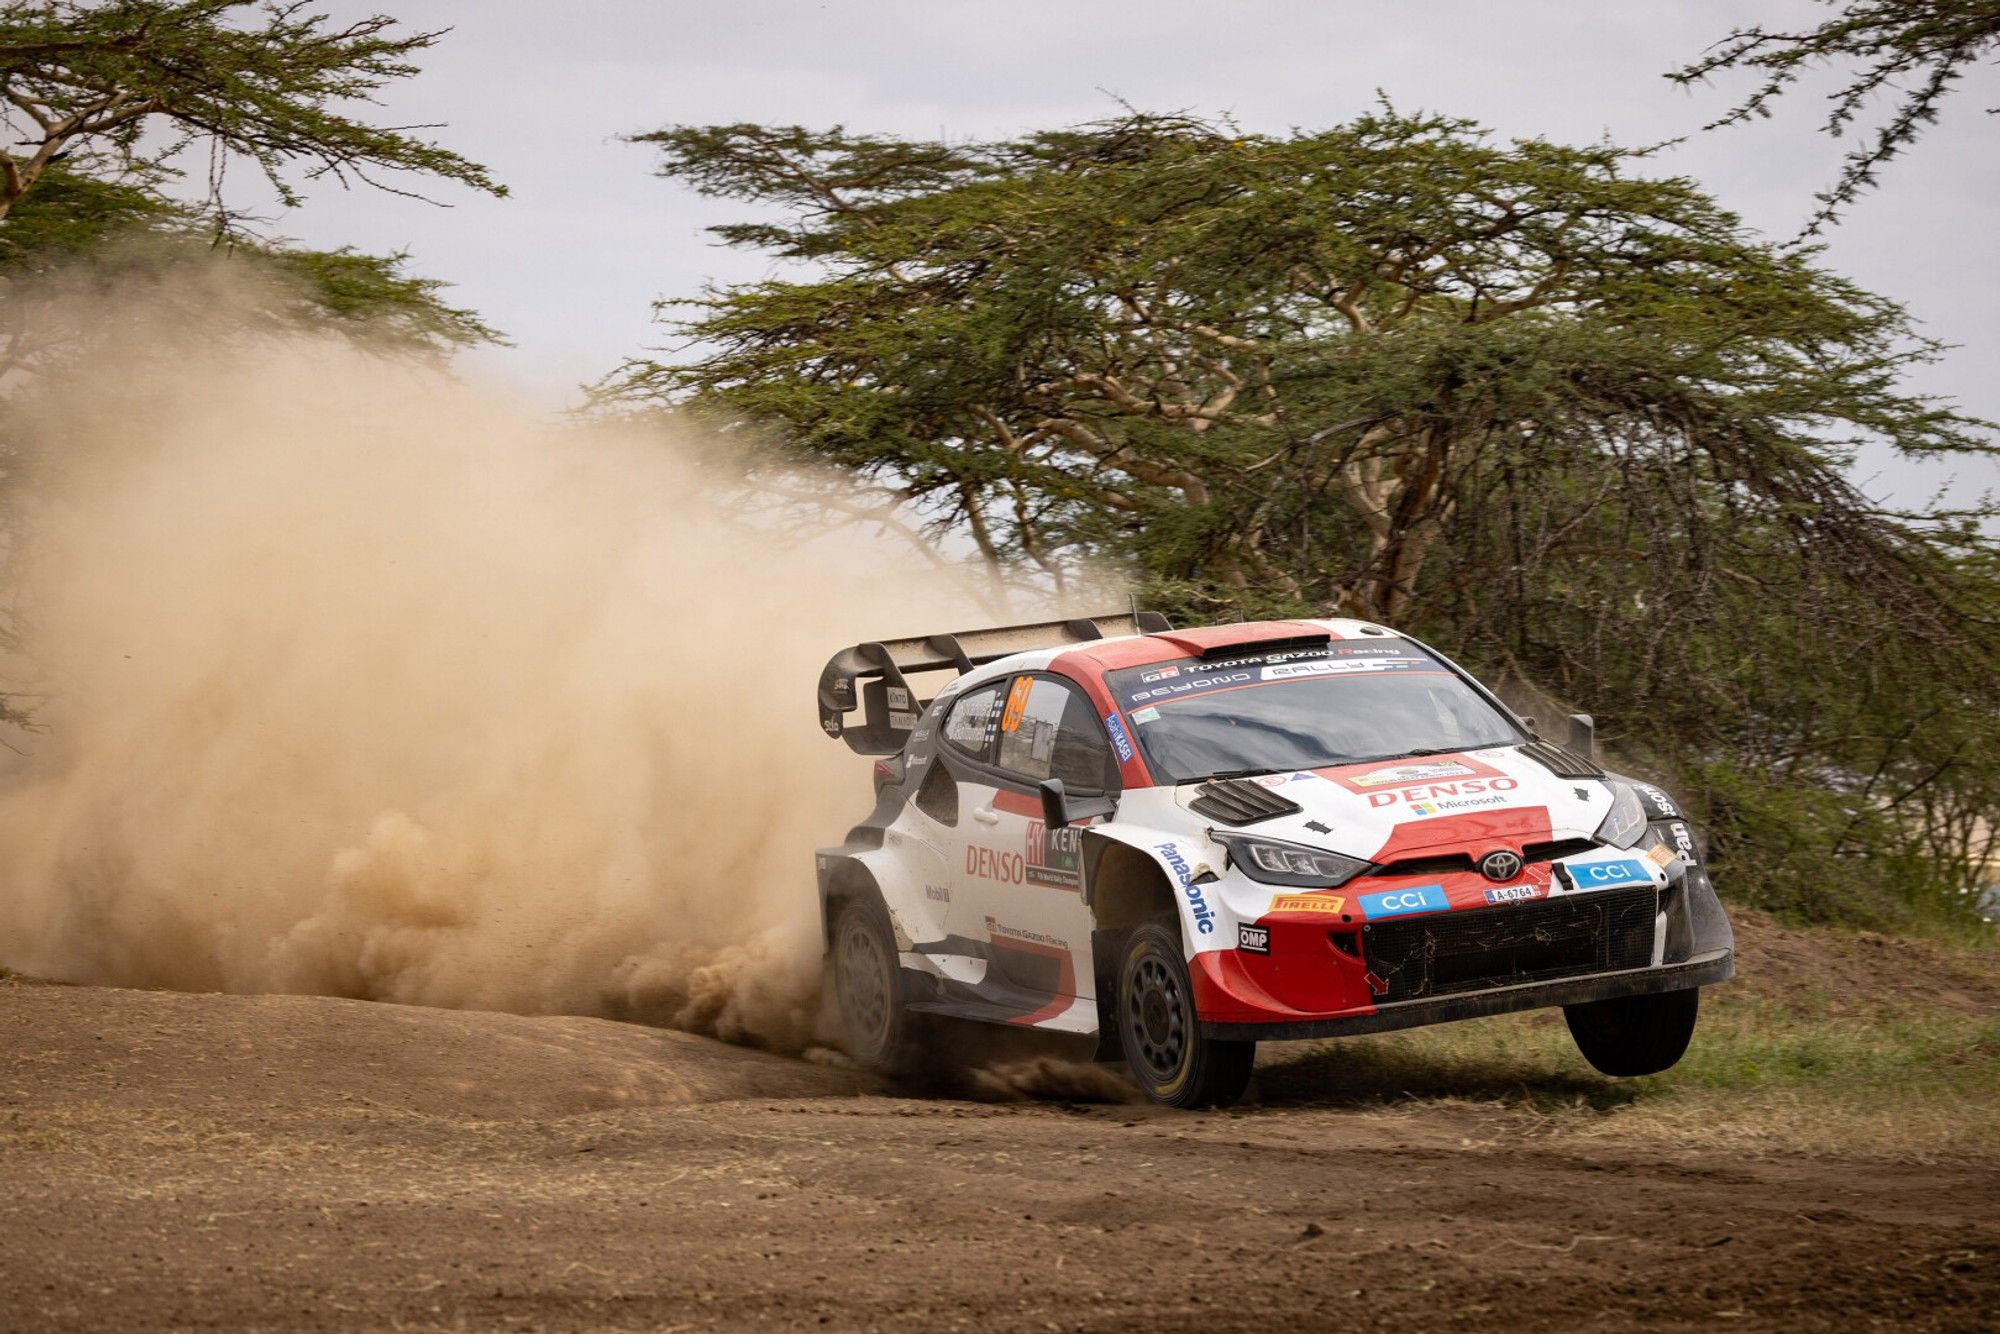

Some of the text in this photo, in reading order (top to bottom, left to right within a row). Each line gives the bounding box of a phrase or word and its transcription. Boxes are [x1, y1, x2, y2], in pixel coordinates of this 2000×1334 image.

[1142, 648, 1400, 682] GR TOYOTA GAZOO Racing
[1131, 661, 1364, 702] BEYOND RALLY
[1368, 778, 1518, 808] DENSO
[1437, 795, 1508, 811] Microsoft
[1051, 828, 1081, 853] KEN
[966, 845, 1023, 884] DENSO
[1153, 843, 1215, 934] Panasonic
[1497, 887, 1532, 900] A-6764
[1274, 896, 1339, 910] PIRELLI
[1240, 931, 1268, 948] OMP
